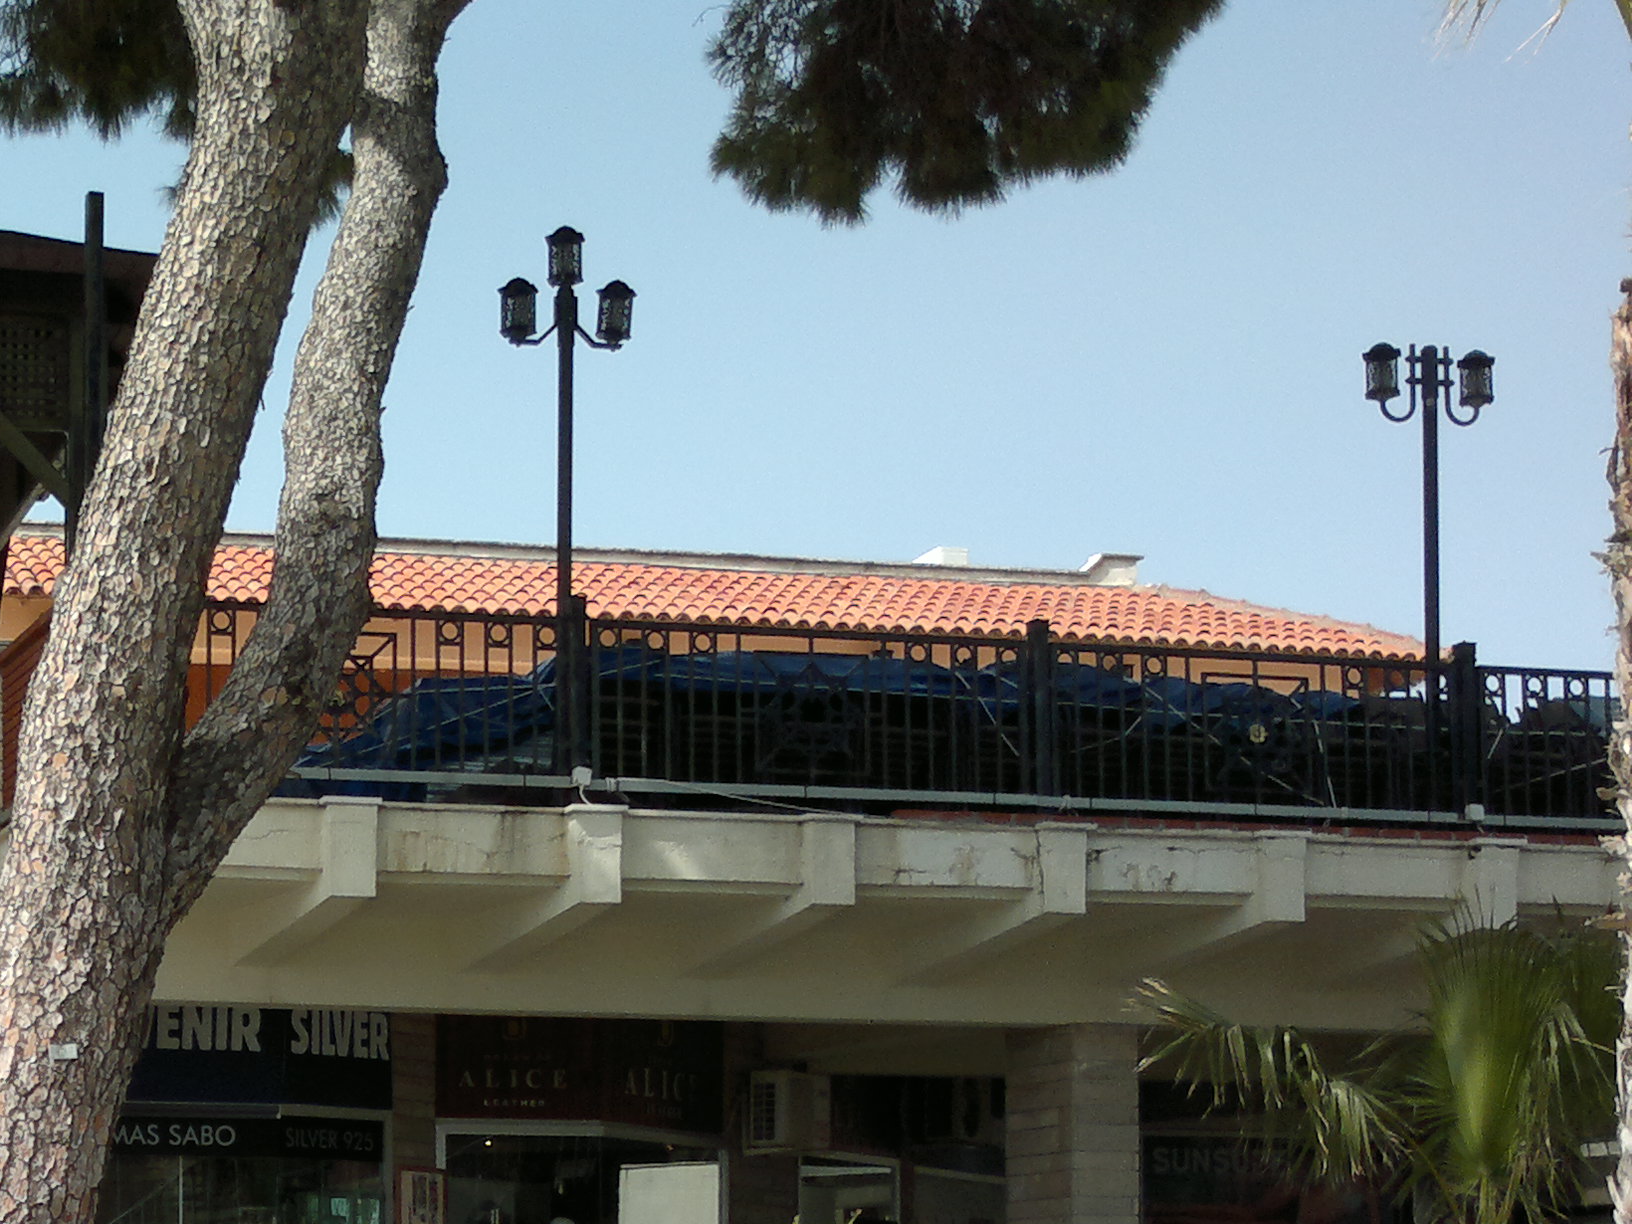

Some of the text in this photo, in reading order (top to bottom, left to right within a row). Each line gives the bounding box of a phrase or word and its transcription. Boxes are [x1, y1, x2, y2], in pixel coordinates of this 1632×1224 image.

[291, 1008, 389, 1060] SILVER
[458, 1067, 568, 1089] ALICE
[168, 1124, 236, 1146] SABO
[286, 1127, 374, 1151] SILVER 925
